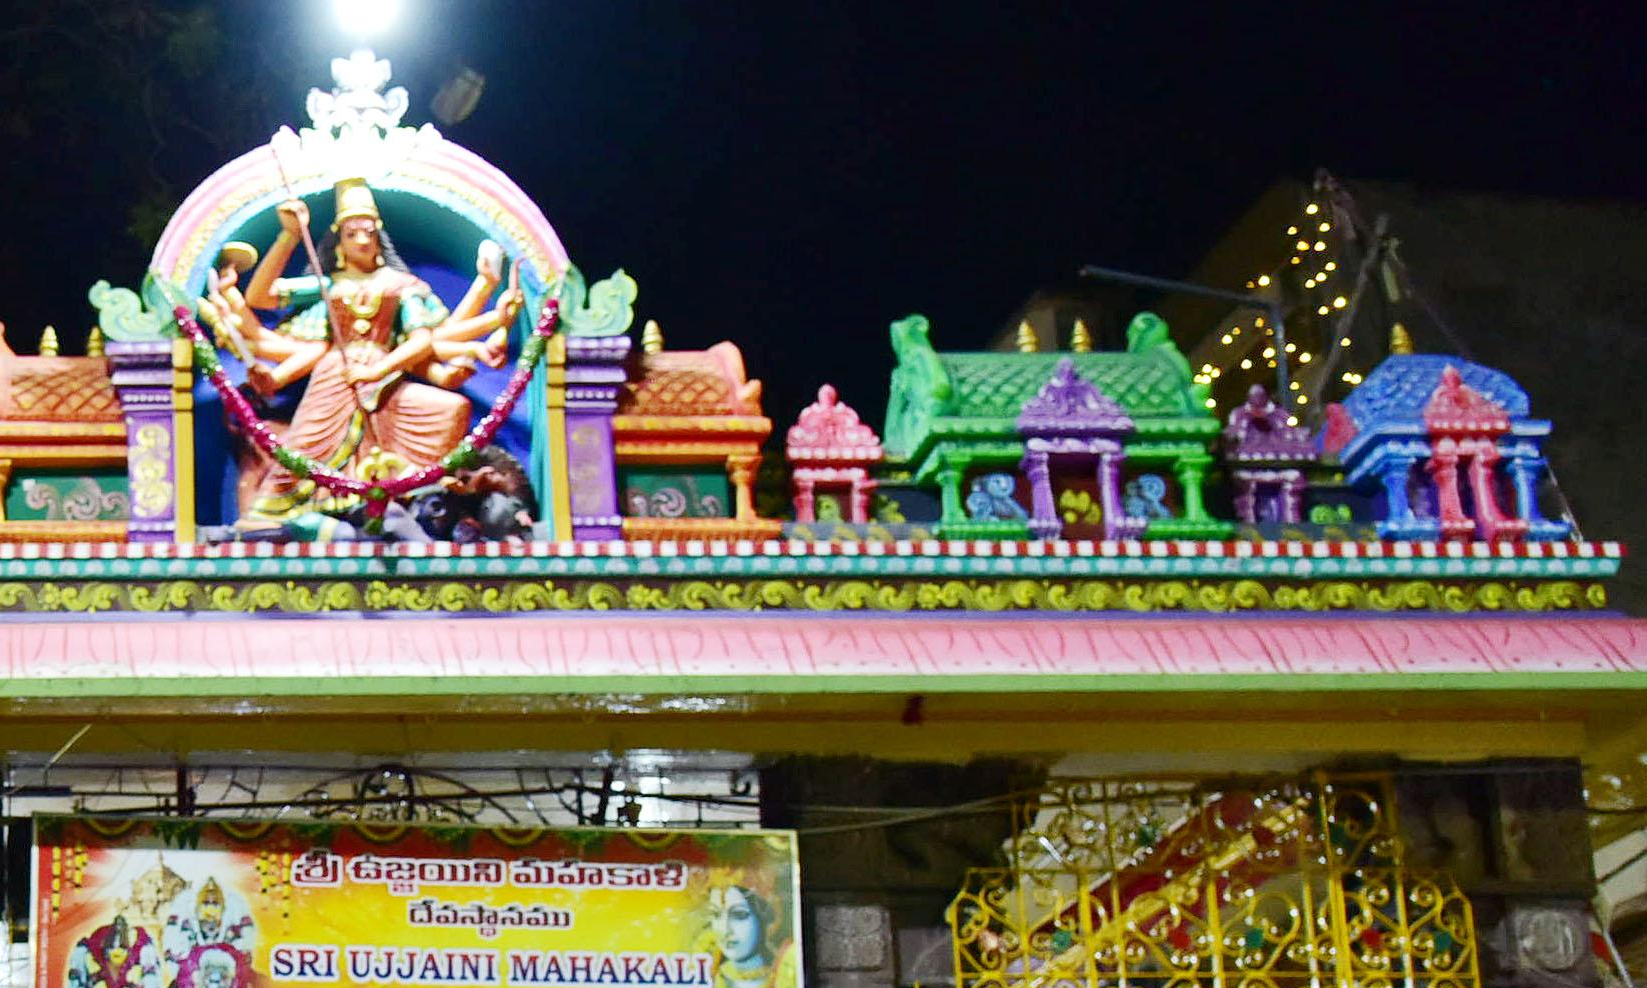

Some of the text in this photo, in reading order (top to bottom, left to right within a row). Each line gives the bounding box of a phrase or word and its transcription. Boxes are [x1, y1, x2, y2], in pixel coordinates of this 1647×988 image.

[295, 850, 339, 883] శ్రీ
[273, 949, 711, 986] SRI UJJAINI MAHAKALI
